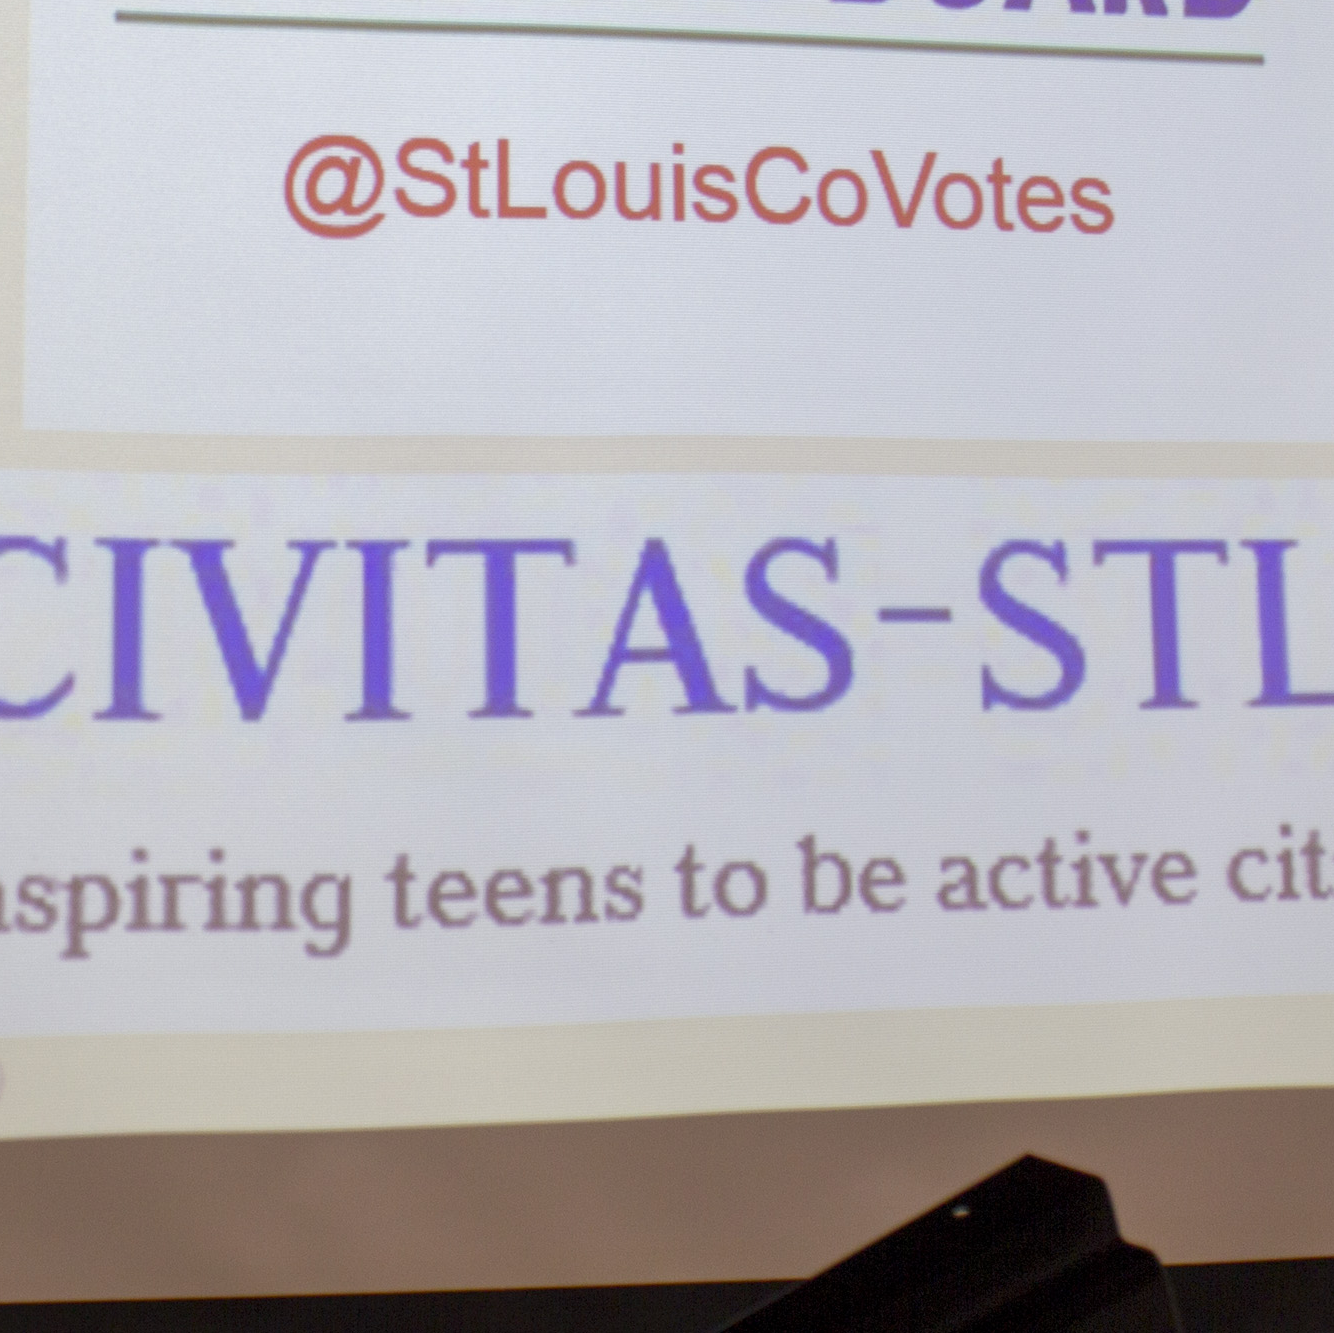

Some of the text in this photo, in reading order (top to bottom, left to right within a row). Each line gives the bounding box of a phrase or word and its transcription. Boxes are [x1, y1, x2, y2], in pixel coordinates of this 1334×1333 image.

[283, 133, 1115, 239] @StLouisCoVotes
[385, 850, 645, 928] teens
[676, 844, 769, 919] to
[796, 834, 907, 915] be
[935, 829, 1199, 911] active
